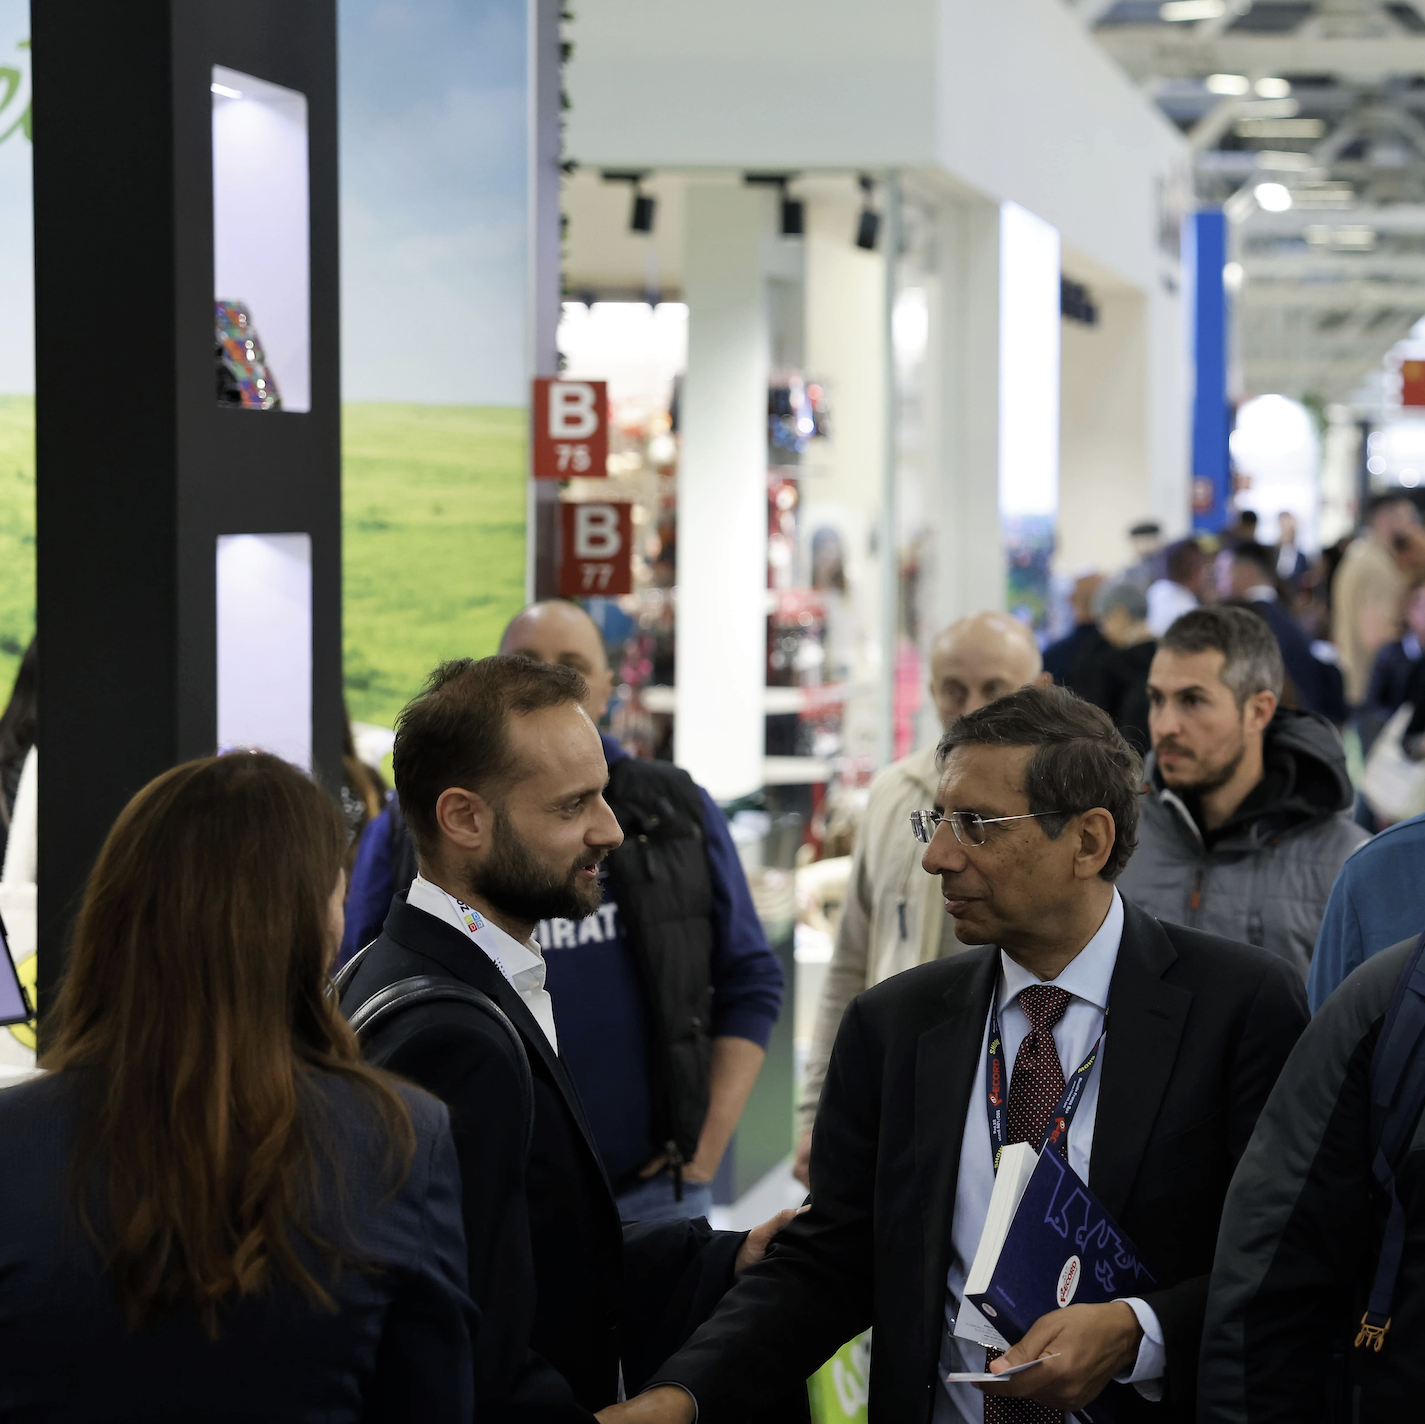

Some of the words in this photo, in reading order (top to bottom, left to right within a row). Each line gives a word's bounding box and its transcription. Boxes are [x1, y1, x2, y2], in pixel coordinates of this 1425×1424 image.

[548, 381, 599, 440] B
[555, 443, 592, 472] 75
[573, 504, 622, 560] B
[531, 902, 618, 950] IRAT
